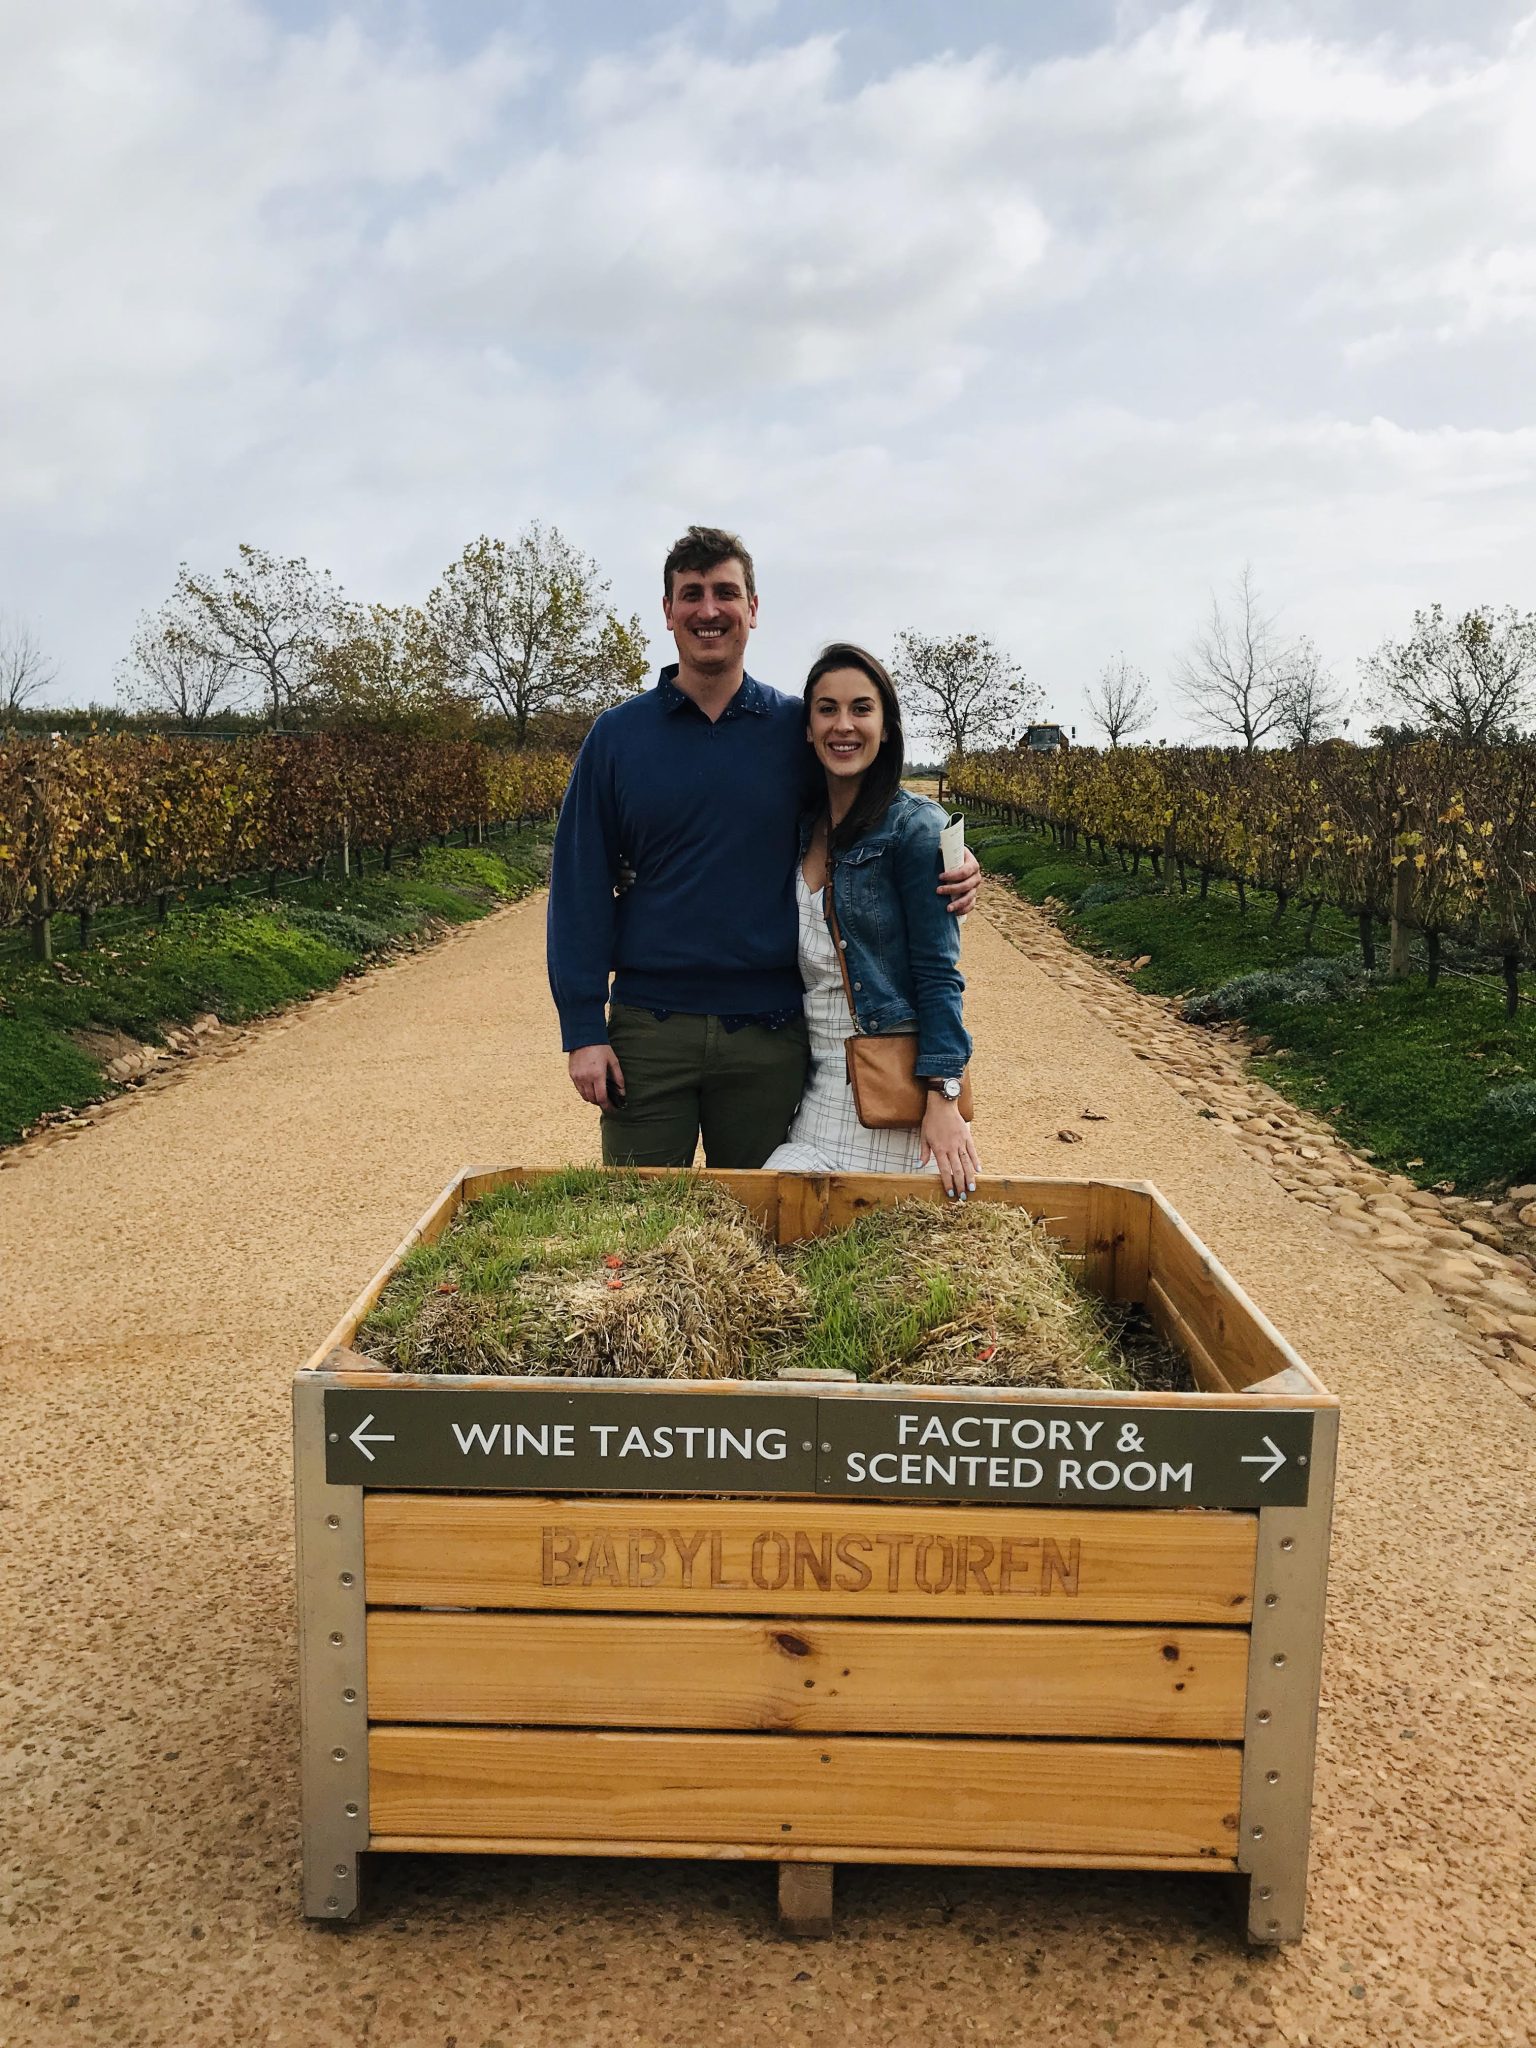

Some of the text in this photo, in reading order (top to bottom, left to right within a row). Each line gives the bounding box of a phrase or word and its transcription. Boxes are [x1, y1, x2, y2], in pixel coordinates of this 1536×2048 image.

[451, 1423, 787, 1460] WINE TASTING
[898, 1414, 1146, 1453] FACTORY &
[846, 1452, 1193, 1492] SCENTED ROOM
[541, 1525, 1081, 1598] BABYLONSTOREN
